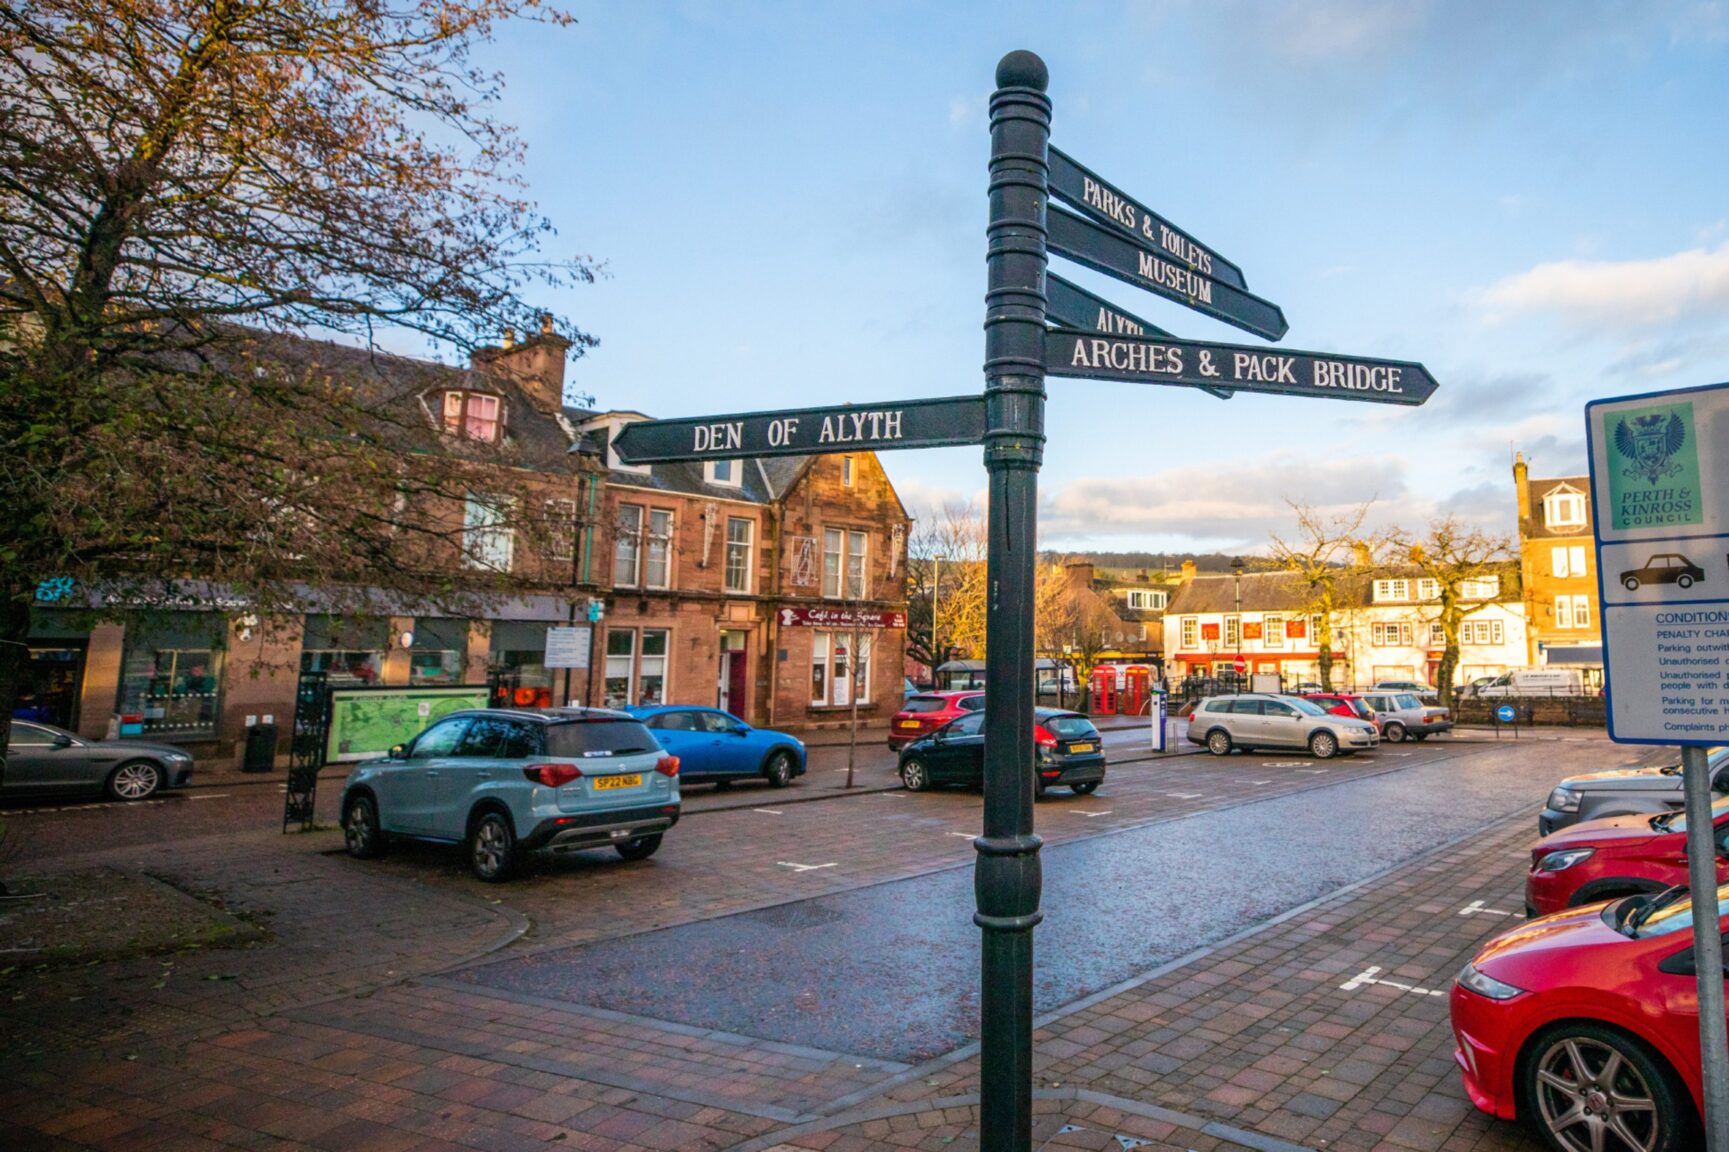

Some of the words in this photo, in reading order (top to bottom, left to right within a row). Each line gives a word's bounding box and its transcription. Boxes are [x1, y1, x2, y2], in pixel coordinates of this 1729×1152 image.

[1083, 176, 1135, 228] PARKS
[1142, 214, 1154, 241] &
[1160, 224, 1212, 275] TOILETS
[1138, 250, 1212, 304] MUSEUM
[1071, 339, 1183, 374] ARCHES
[1199, 350, 1220, 377] &
[1234, 353, 1297, 384] PACK
[1313, 360, 1403, 393] BRIDGE
[693, 422, 744, 452] DEN
[767, 418, 799, 447] OF
[819, 411, 903, 443] ALYTH
[1622, 488, 1674, 504] PERTH
[1679, 487, 1692, 499] &
[1622, 500, 1692, 516] KINROSS
[1623, 513, 1692, 526] COUNCIL
[1656, 611, 1729, 624] CONDITION
[1657, 630, 1700, 639] PENALTY
[1658, 644, 1691, 654] Parking
[1659, 657, 1720, 665] Unauthorised
[1660, 671, 1721, 679] Unauthorised
[1661, 681, 1691, 691] people
[1696, 681, 1718, 689] with
[1662, 696, 1696, 706] Parking
[1701, 696, 1713, 705] for
[1663, 707, 1719, 715] consecutive
[1664, 721, 1715, 732] Complaints
